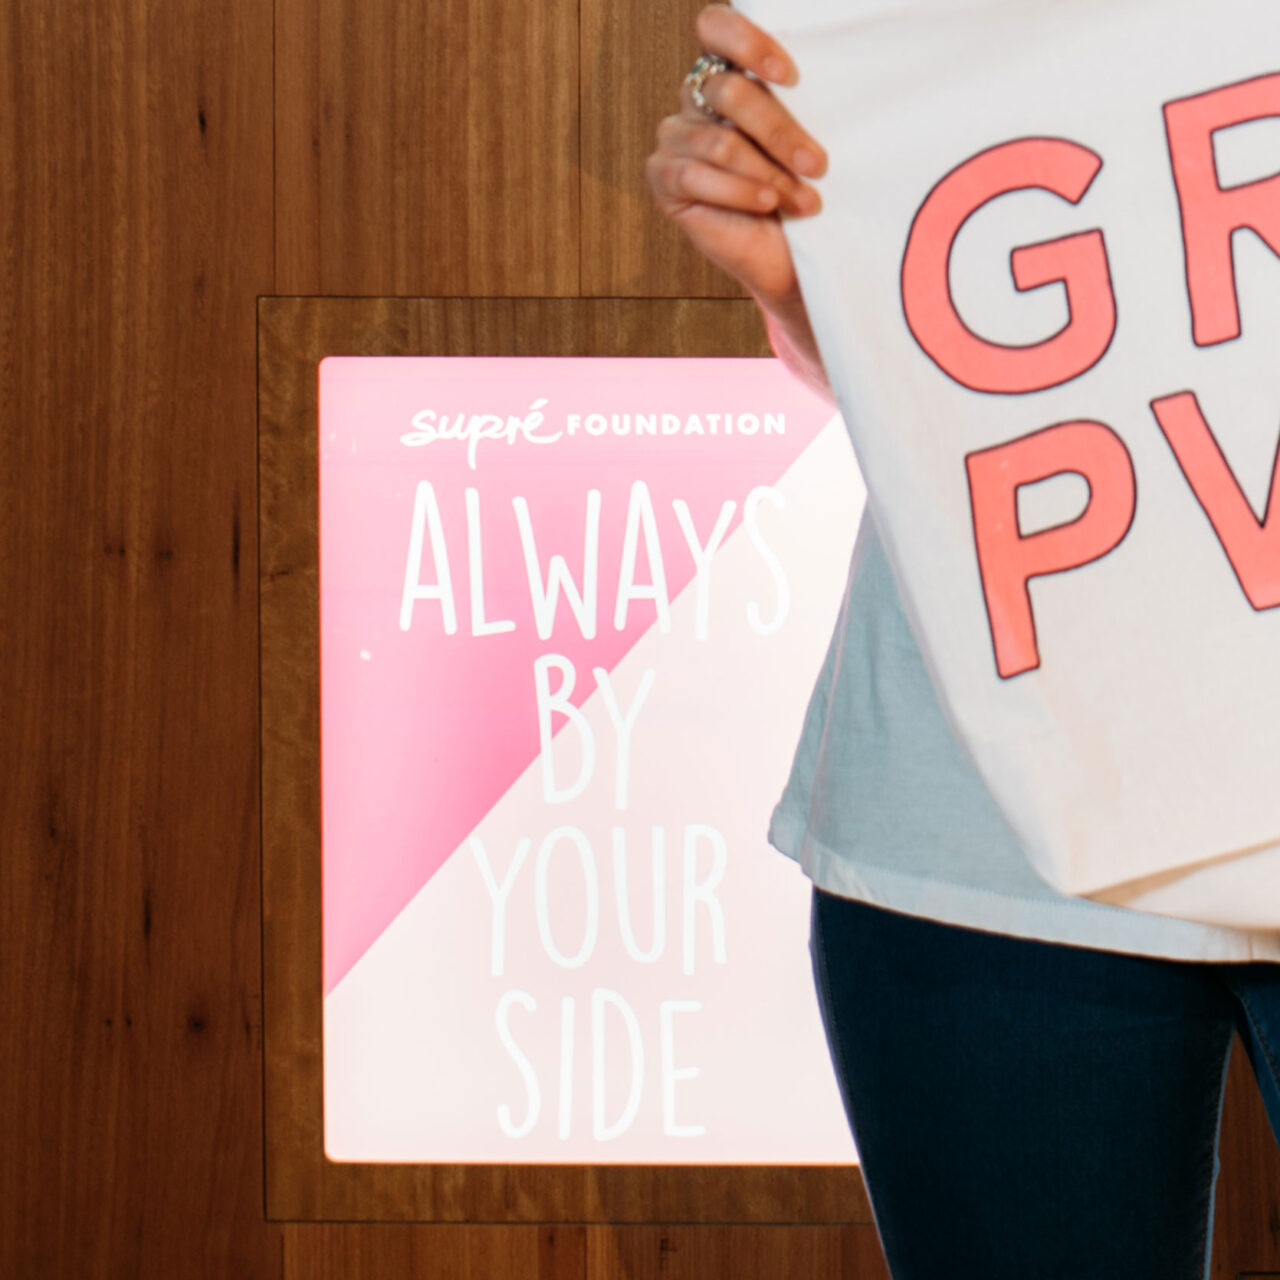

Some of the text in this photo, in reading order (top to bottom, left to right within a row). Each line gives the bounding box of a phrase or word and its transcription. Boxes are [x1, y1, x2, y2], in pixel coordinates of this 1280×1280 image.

[566, 412, 786, 436] FOUNDATION
[398, 479, 792, 642] ALWAYS
[534, 652, 656, 810] BY
[467, 822, 728, 977] YOUR
[494, 987, 708, 1141] SIDE
